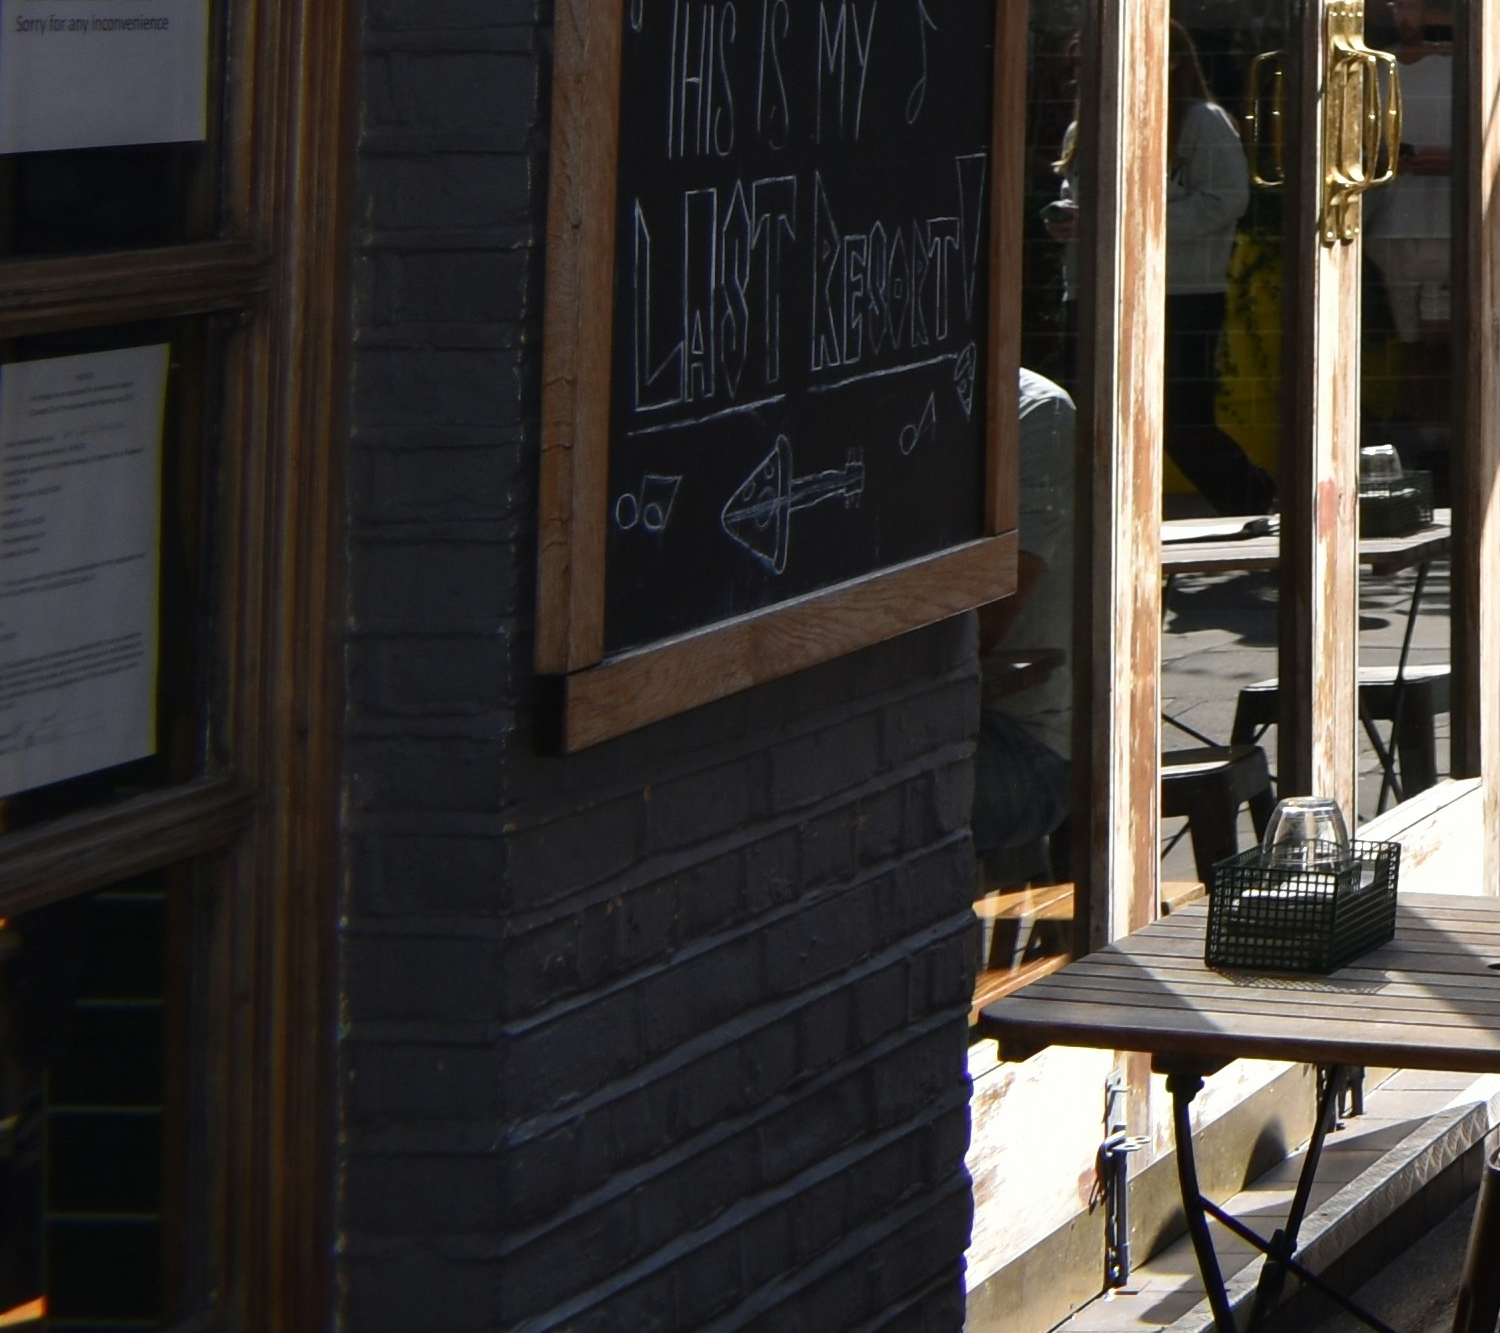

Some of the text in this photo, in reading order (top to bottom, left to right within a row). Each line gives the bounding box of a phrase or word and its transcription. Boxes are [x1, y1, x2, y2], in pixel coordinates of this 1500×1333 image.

[16, 14, 170, 35] Sorry for any inconvenience
[633, 174, 797, 413] LAST
